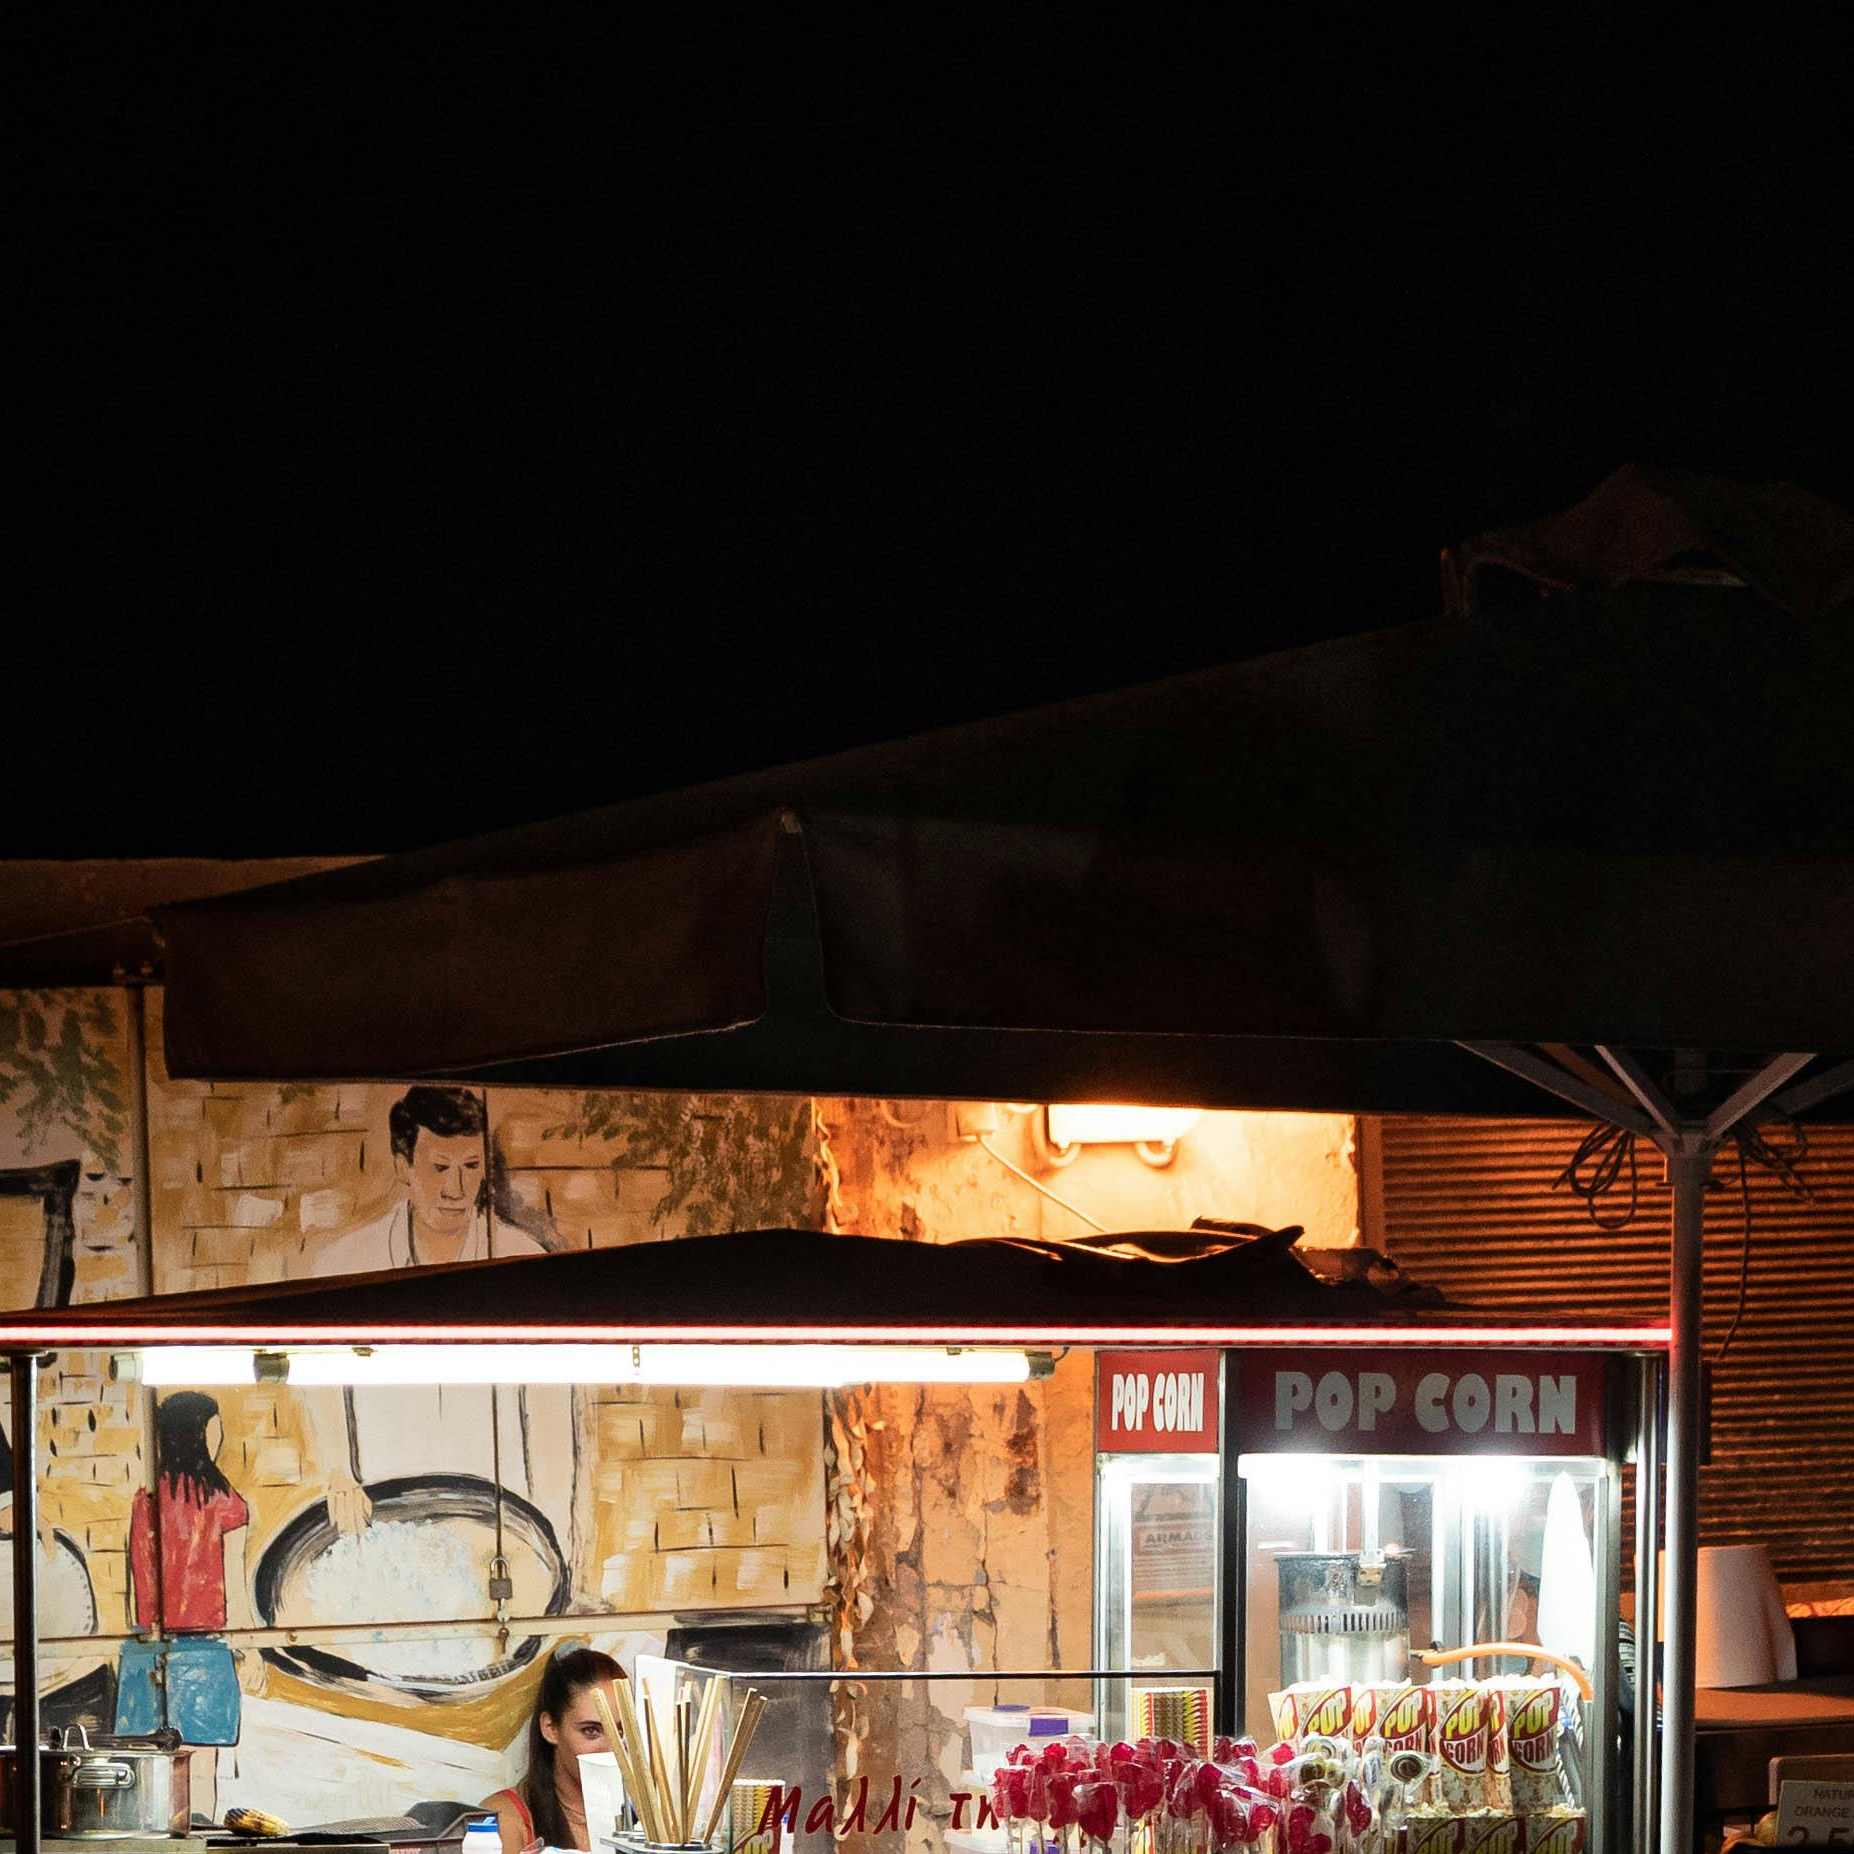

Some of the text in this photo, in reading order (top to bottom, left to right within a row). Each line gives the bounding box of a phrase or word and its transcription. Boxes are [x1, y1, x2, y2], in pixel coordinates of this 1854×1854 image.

[1111, 1372, 1204, 1432] POP CORN
[1274, 1371, 1577, 1435] POP CORN
[1513, 1690, 1554, 1739] POP
[1446, 1731, 1485, 1764] CORN
[1514, 1731, 1554, 1763] CORN
[1794, 1805, 1848, 1818] ORANGE
